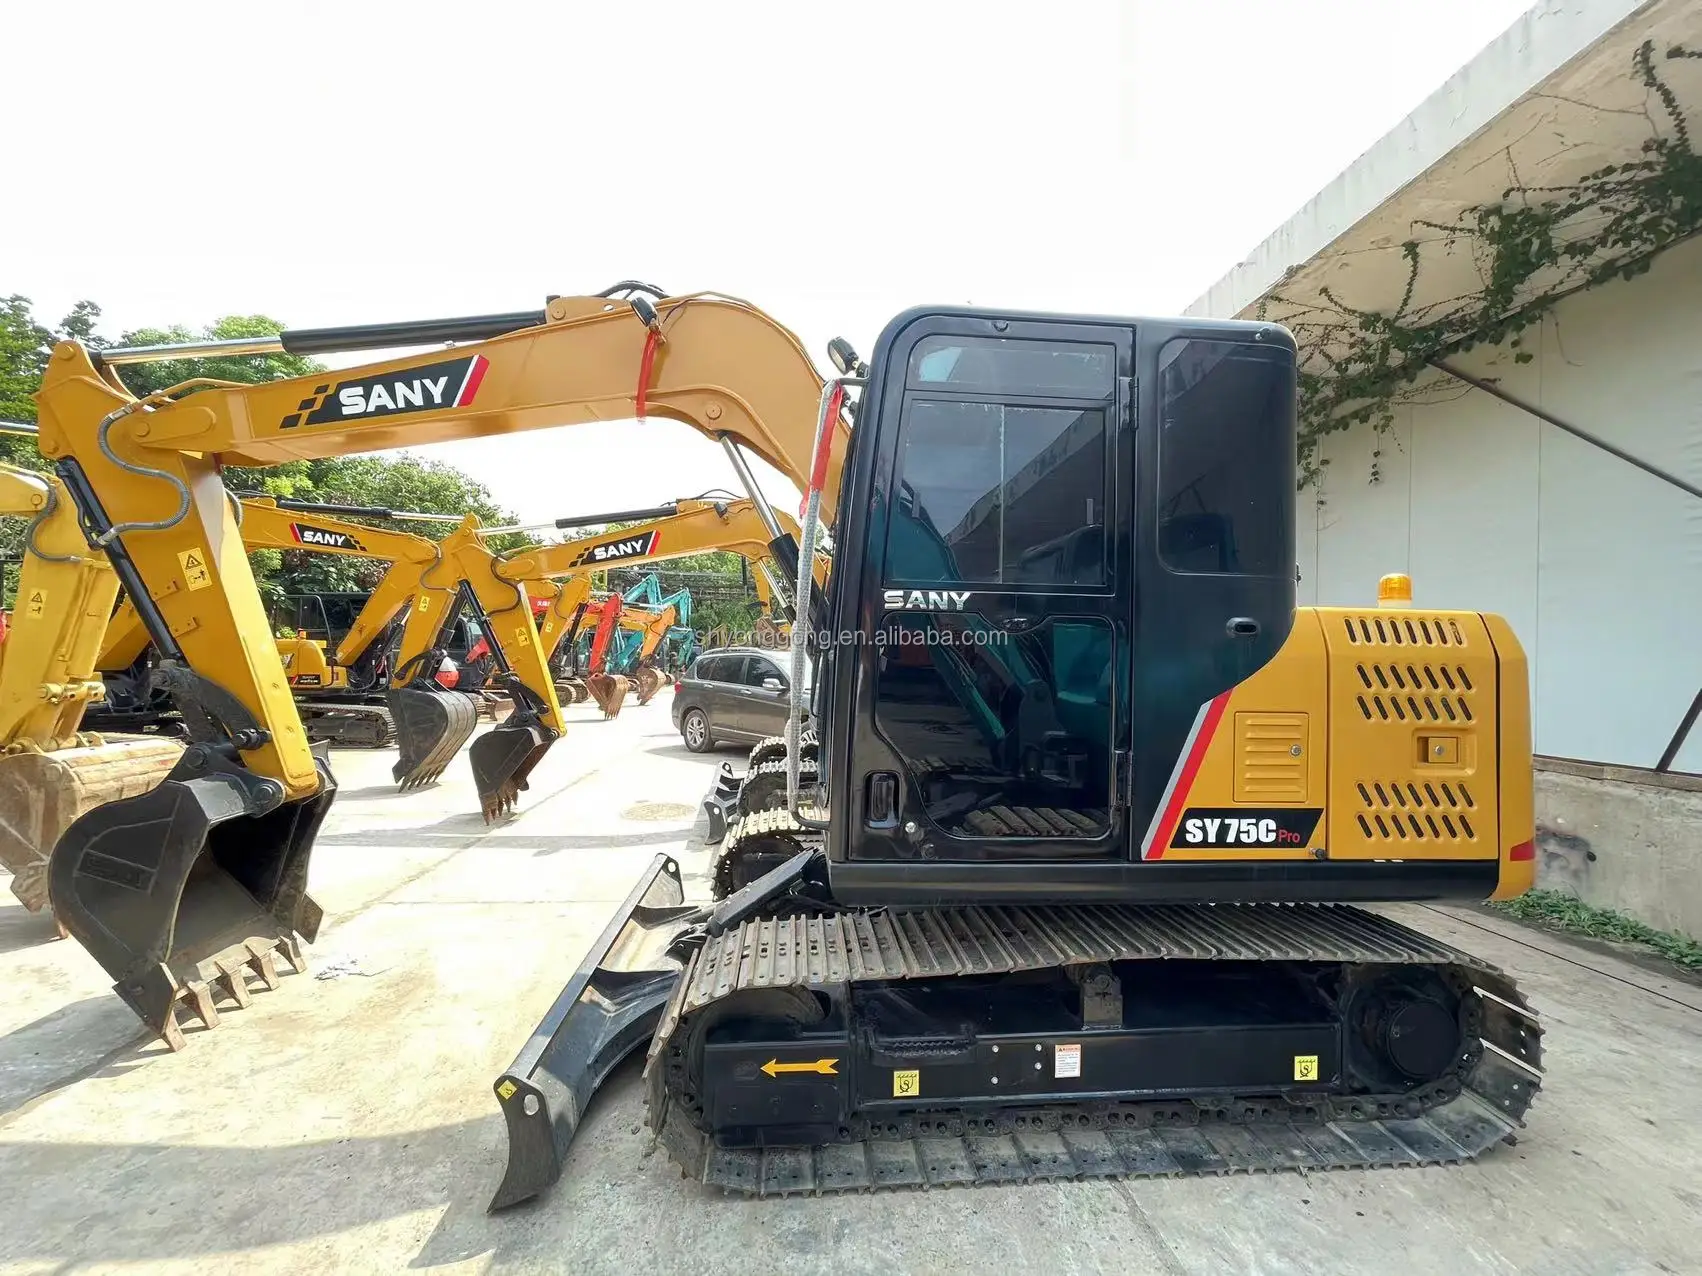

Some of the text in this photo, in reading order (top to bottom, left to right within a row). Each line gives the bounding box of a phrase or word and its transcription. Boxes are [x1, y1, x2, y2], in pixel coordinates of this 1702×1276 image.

[339, 376, 449, 415] SANY
[303, 530, 346, 546] SANY
[594, 539, 643, 560] SANY
[883, 590, 971, 610] SANY
[1278, 829, 1300, 843] Pro
